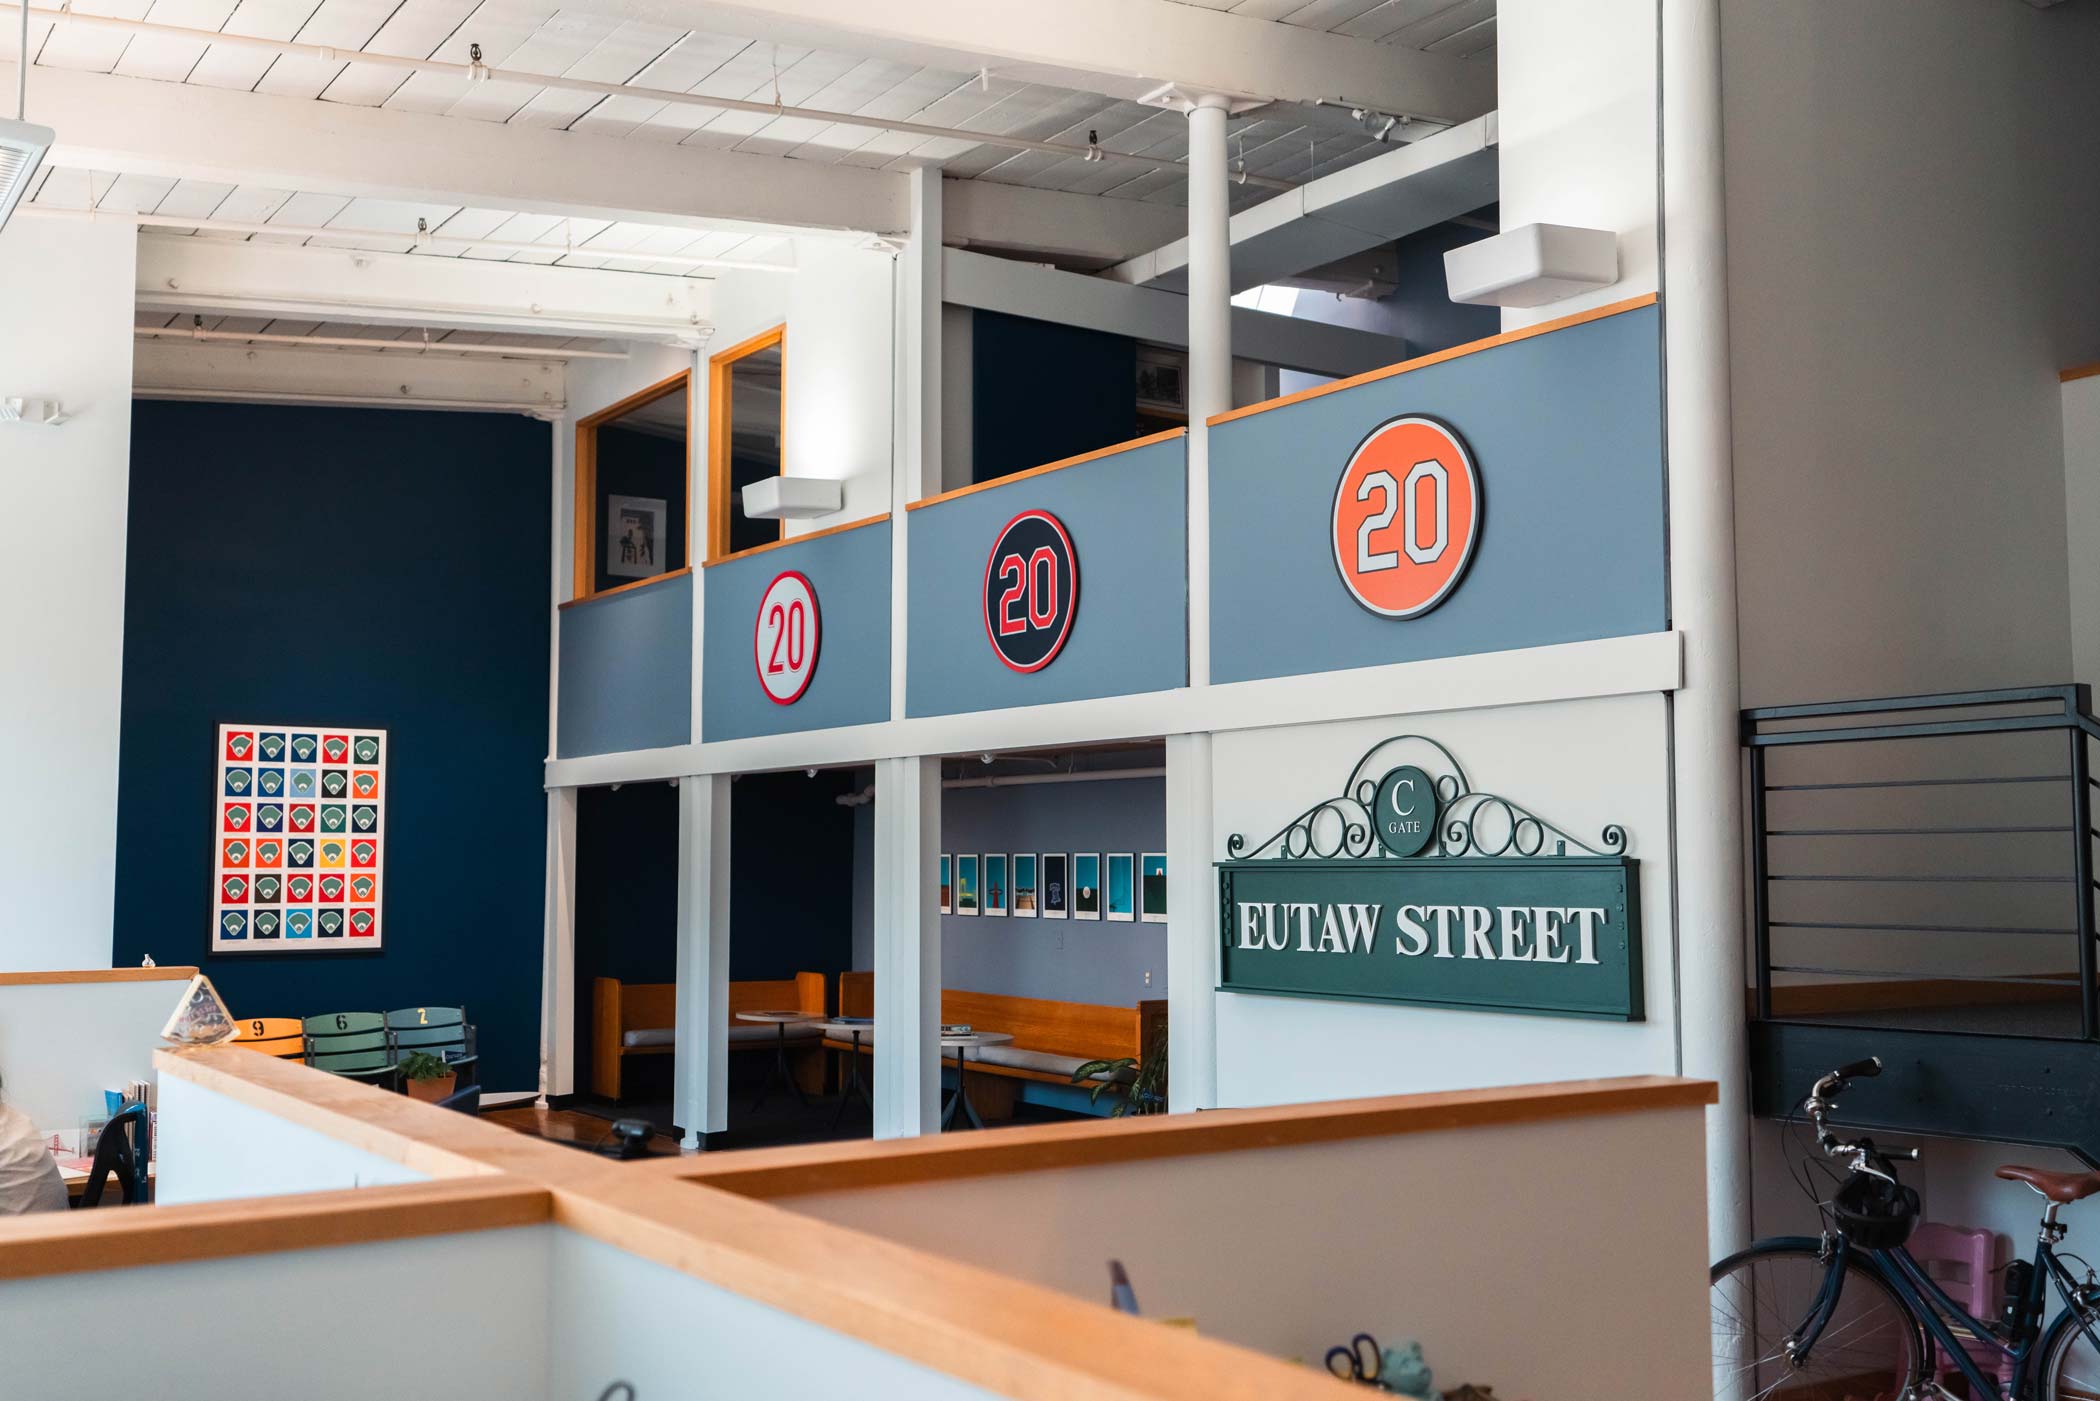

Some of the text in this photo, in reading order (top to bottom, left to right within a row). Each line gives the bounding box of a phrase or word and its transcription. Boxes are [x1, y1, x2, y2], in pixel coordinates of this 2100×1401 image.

[1357, 458, 1449, 574] 20
[999, 545, 1058, 637] 20
[767, 598, 805, 676] 20
[1391, 779, 1415, 816] C
[1388, 821, 1421, 834] GATE
[1237, 902, 1609, 965] EUTAW STREET
[252, 1020, 264, 1037] 9
[336, 1014, 348, 1031] 6
[416, 1007, 429, 1025] 2
